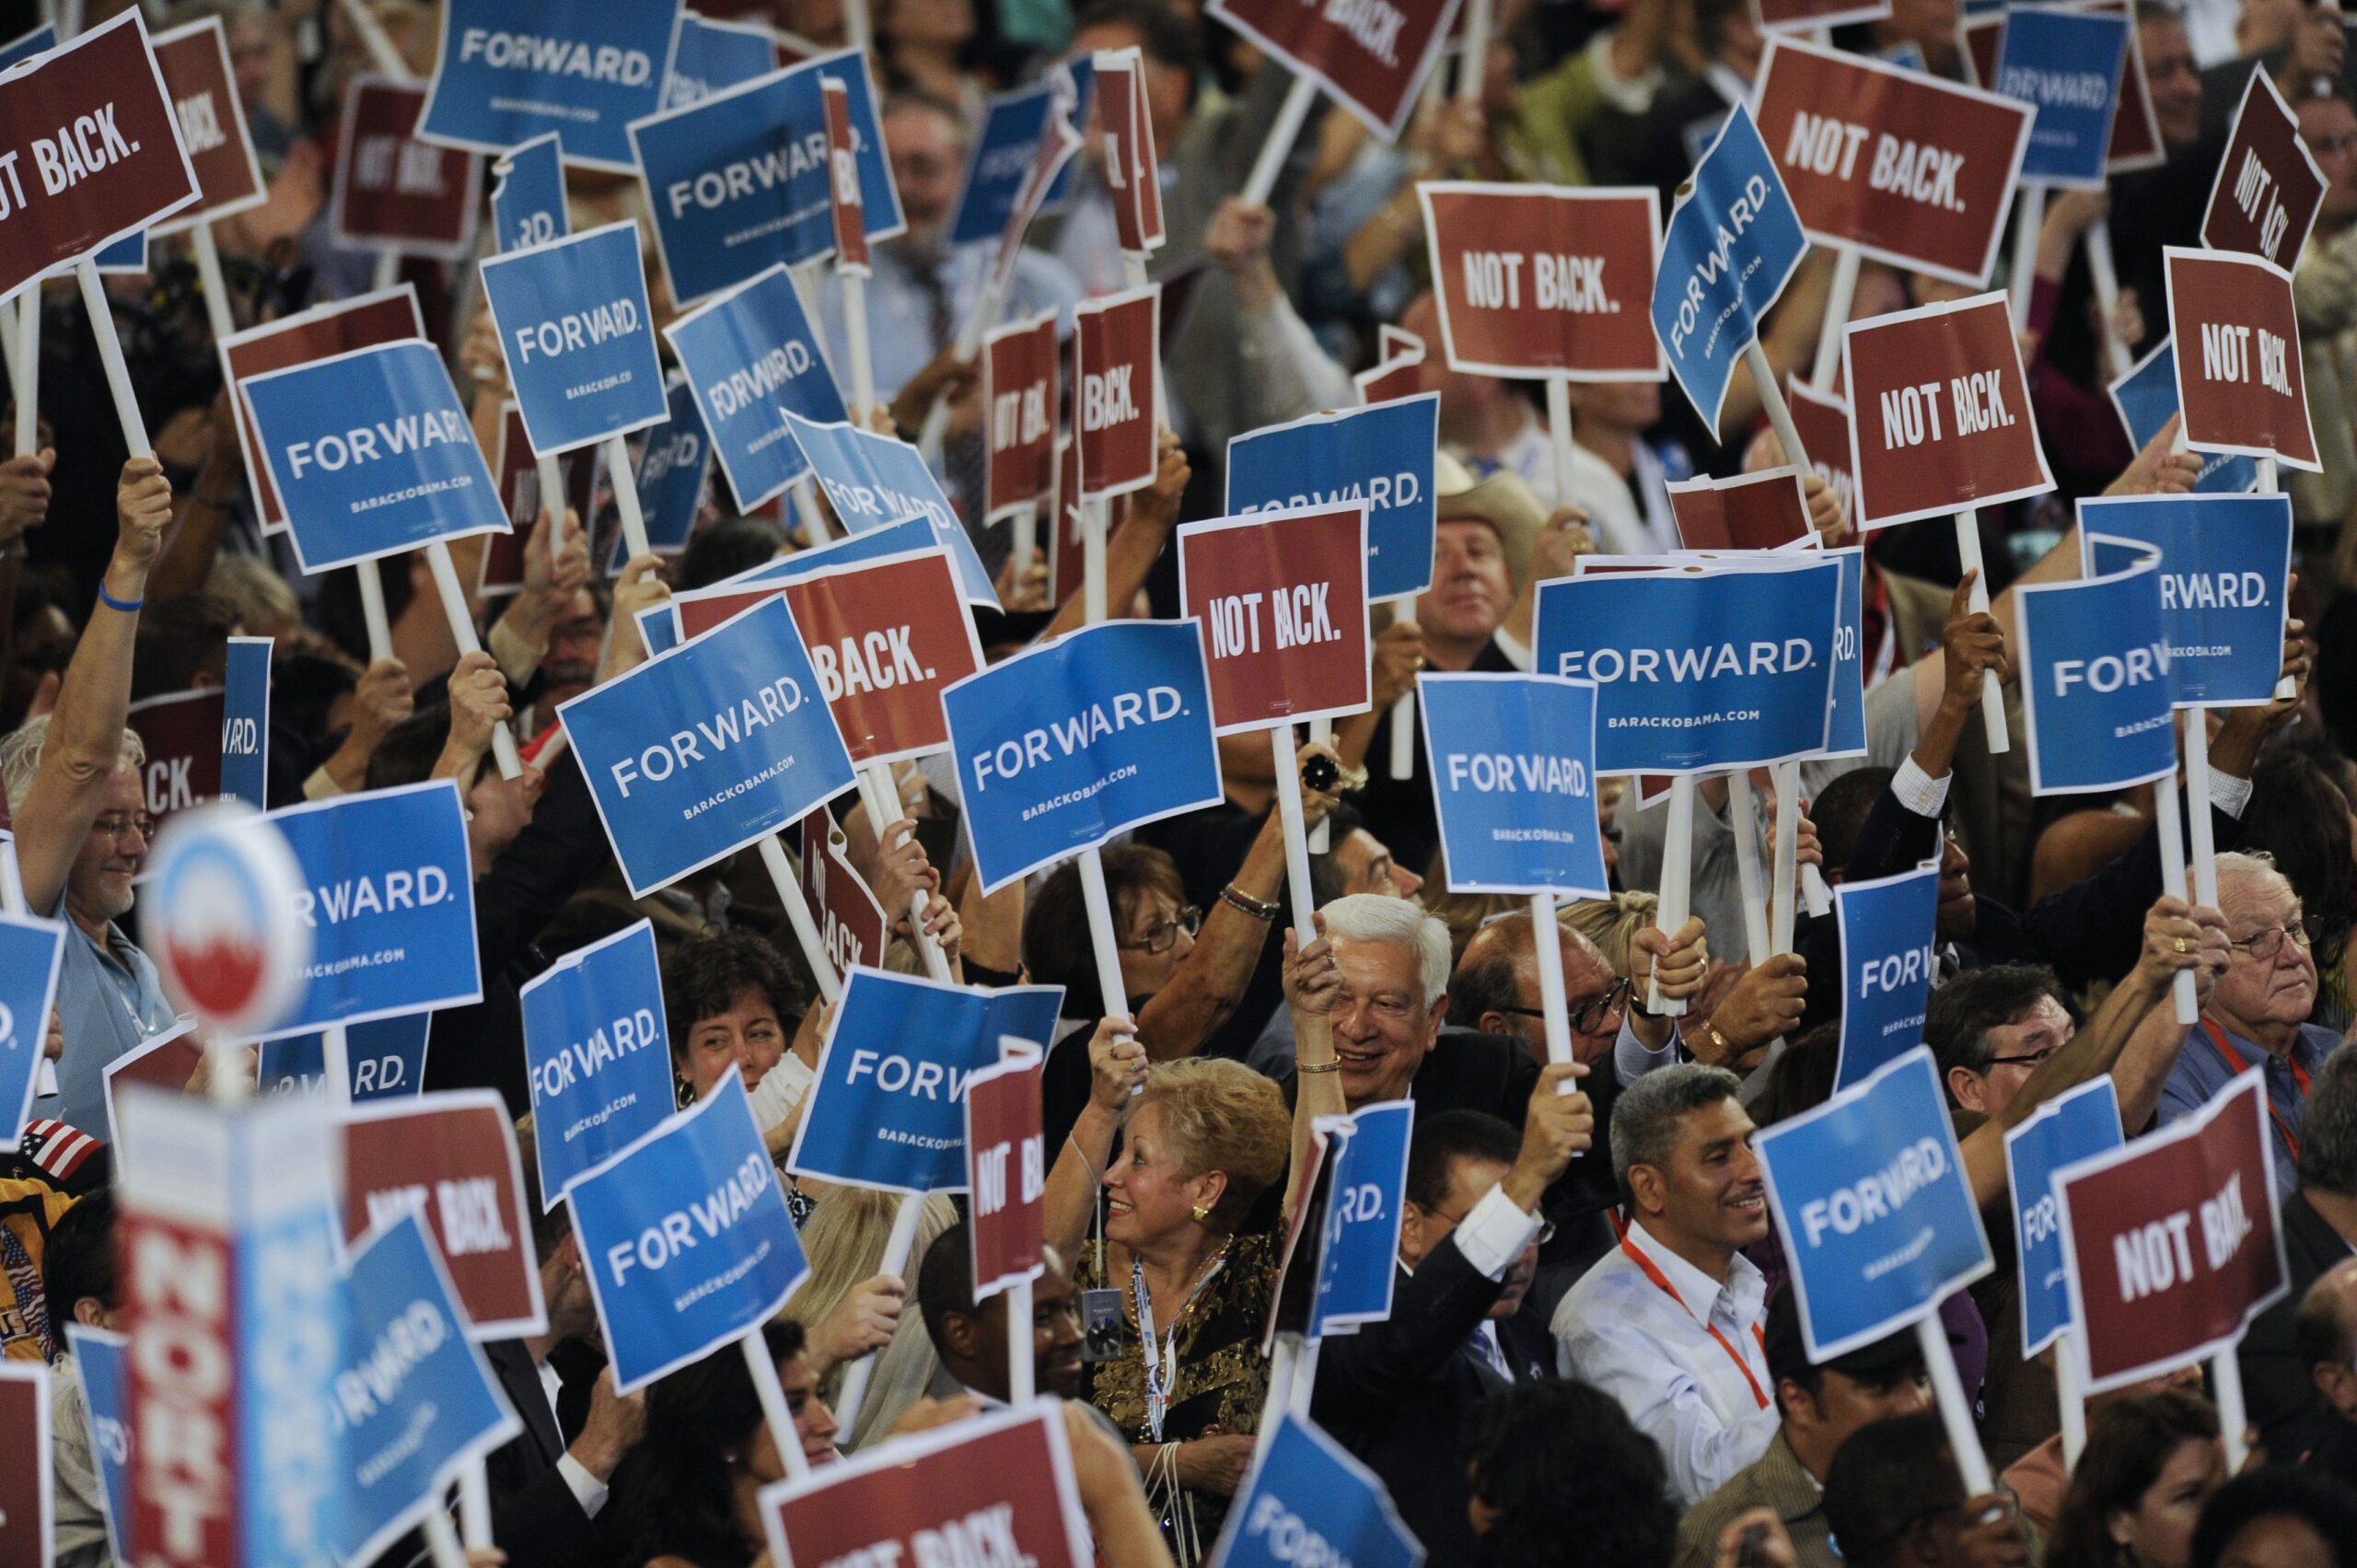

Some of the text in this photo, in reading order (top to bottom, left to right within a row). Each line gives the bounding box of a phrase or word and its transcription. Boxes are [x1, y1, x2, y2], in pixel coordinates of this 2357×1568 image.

[459, 29, 653, 87] FORWARD.
[31, 102, 140, 196] BACK.
[1785, 111, 1966, 213] NOT BACK.
[1463, 250, 1620, 314] NOT BACK.
[1670, 174, 1771, 360] FORWARD.
[2201, 323, 2250, 383] NOT
[1881, 369, 2015, 450] NOT BACK.
[1209, 582, 1341, 659] NOT BACK.
[2160, 571, 2270, 610] RWARD.
[810, 625, 936, 703] BACK.
[1559, 637, 1817, 683] FORWARD.
[610, 676, 810, 798] FORWARD.
[972, 686, 1190, 792] FORWARD.
[1608, 710, 1760, 728] BARACKOBAMA.COM
[147, 756, 203, 815] CK.
[683, 755, 795, 820] BARACKOBAMA.COM
[1022, 764, 1137, 821] BARACKOBAMA.COM
[1447, 753, 1590, 798] FORWARD.
[289, 865, 455, 928] RWARD.
[531, 1009, 659, 1106] FORWARD.
[608, 1153, 772, 1288] FORWARD.
[2113, 1209, 2194, 1304] NOT
